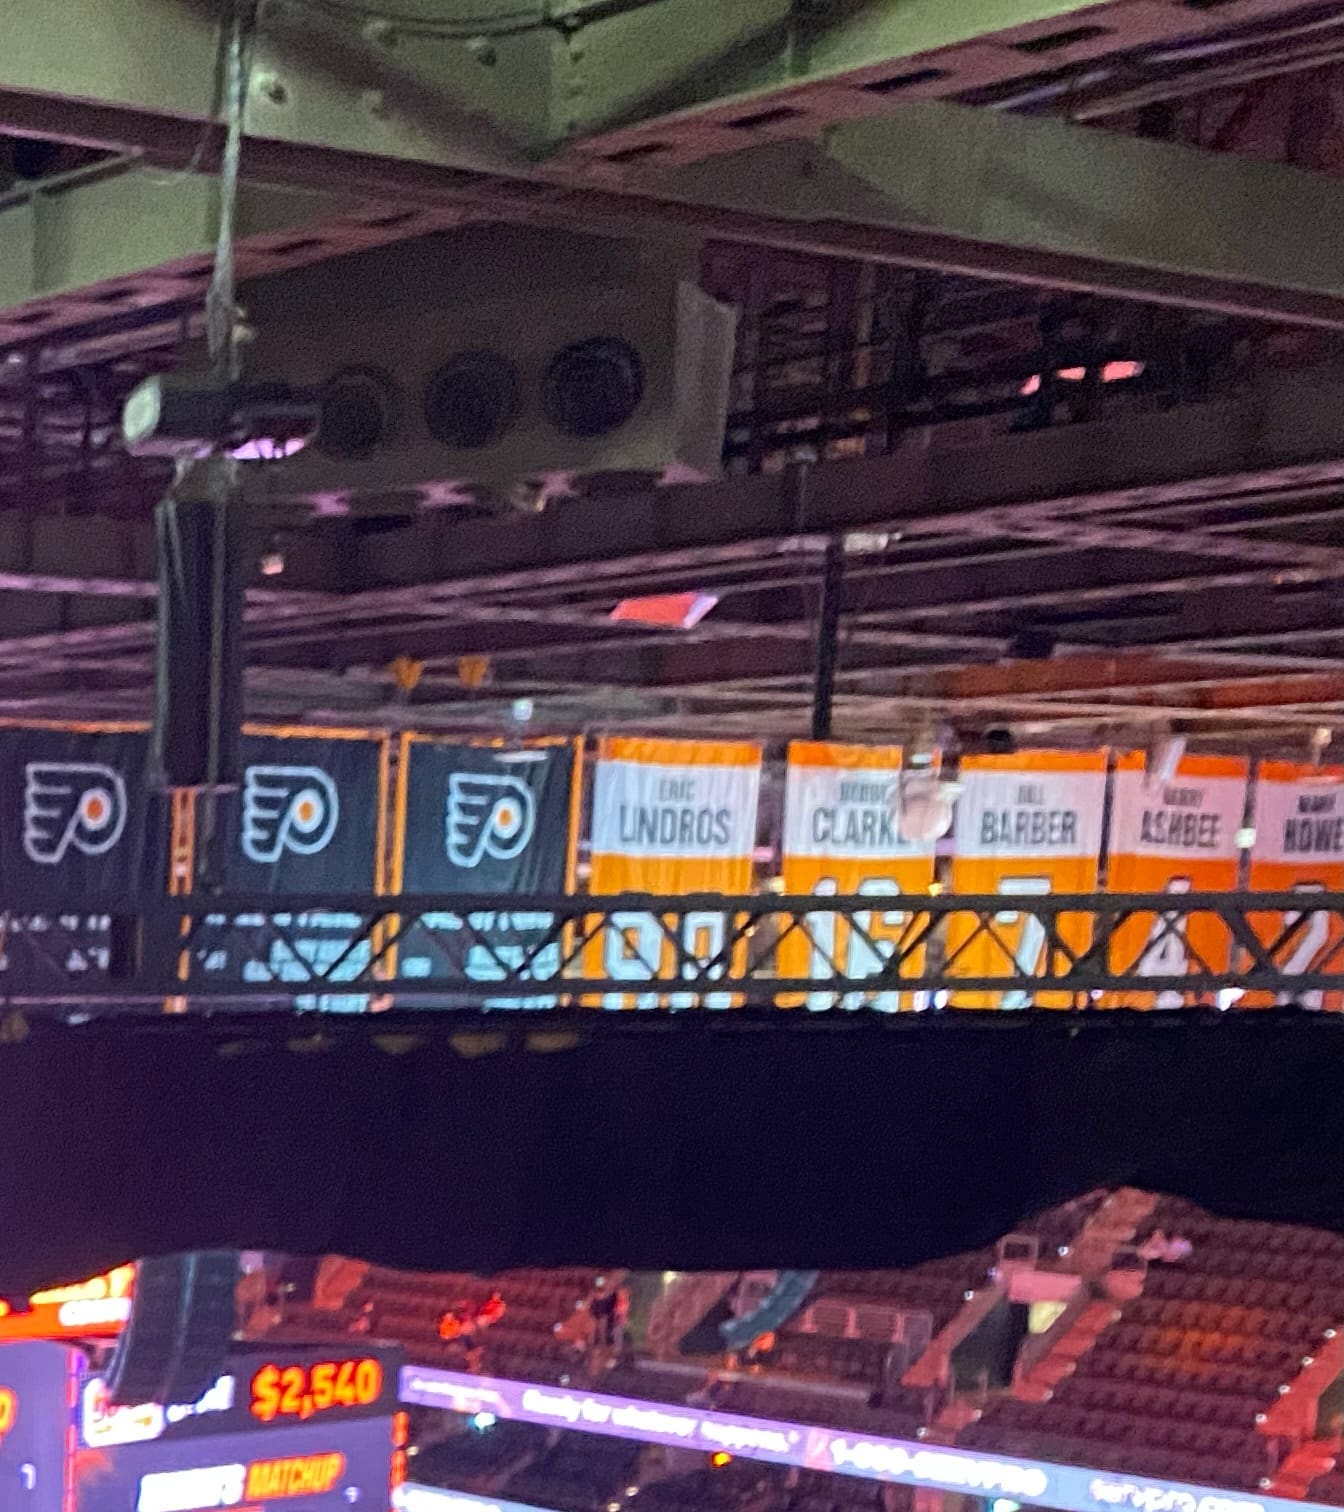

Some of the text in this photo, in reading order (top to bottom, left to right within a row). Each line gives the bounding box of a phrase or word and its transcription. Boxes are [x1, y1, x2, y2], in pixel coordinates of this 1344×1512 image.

[619, 804, 732, 845] LINDROS
[812, 806, 914, 847] CLARK
[980, 809, 1078, 846] BARBER
[1139, 809, 1222, 848] ASHBEE
[250, 1357, 382, 1421] $2,540
[244, 1452, 346, 1501] MATCHUP
